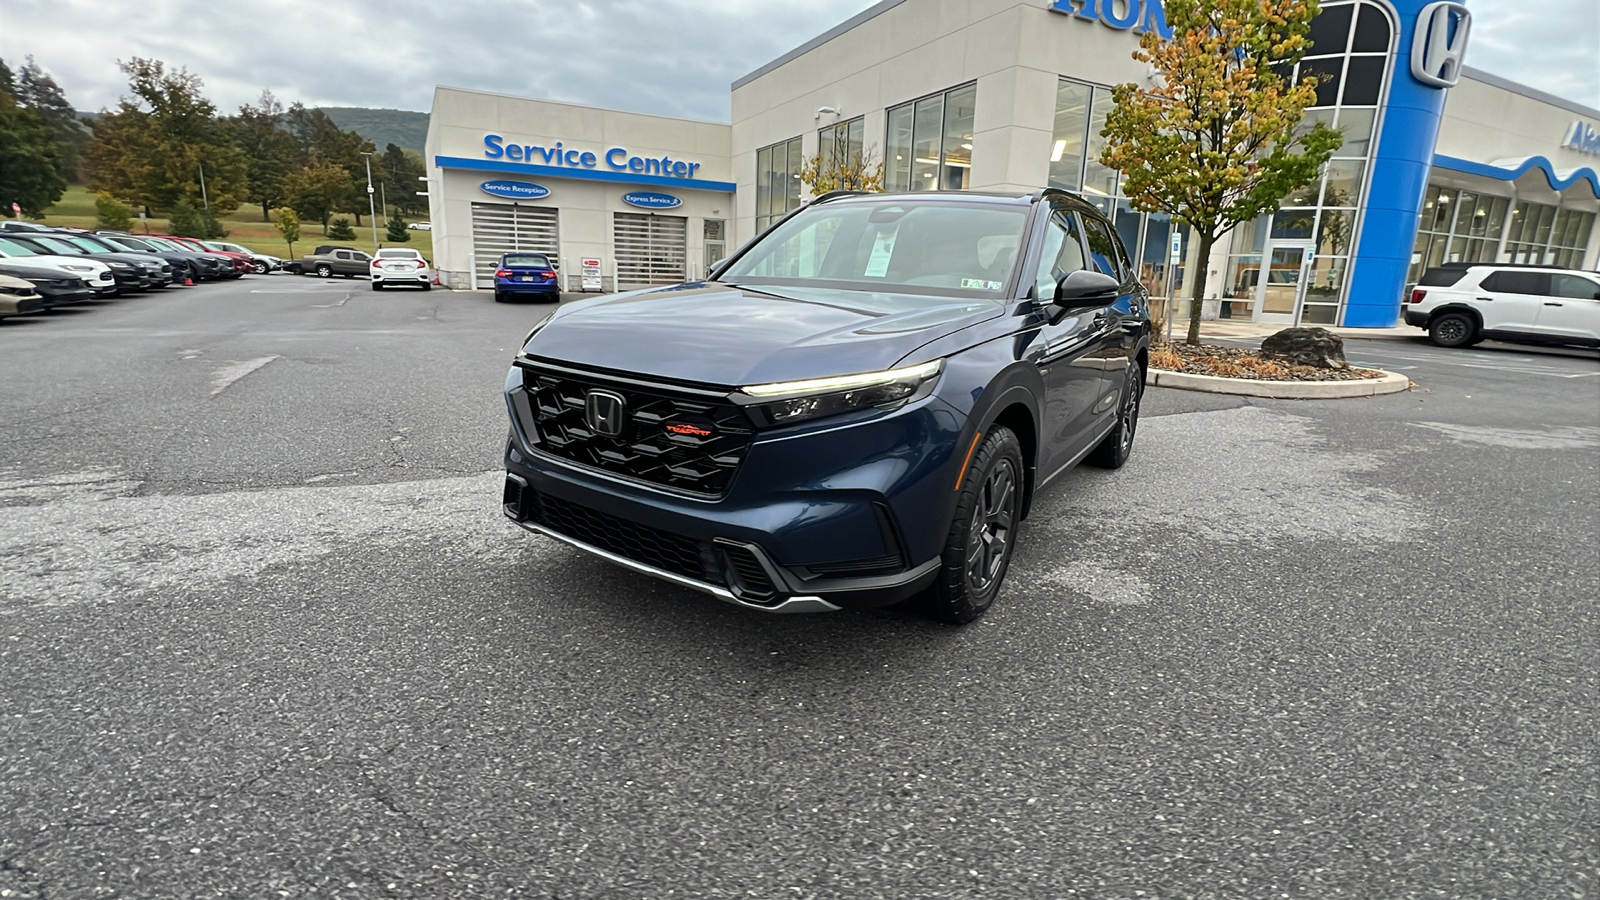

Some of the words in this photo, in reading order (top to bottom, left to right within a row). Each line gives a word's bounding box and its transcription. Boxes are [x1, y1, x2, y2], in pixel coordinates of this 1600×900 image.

[483, 134, 597, 168] Service
[605, 147, 700, 178] Center
[484, 183, 511, 191] Service
[512, 185, 547, 194] Reception
[626, 194, 649, 203] Express
[649, 196, 670, 204] Service
